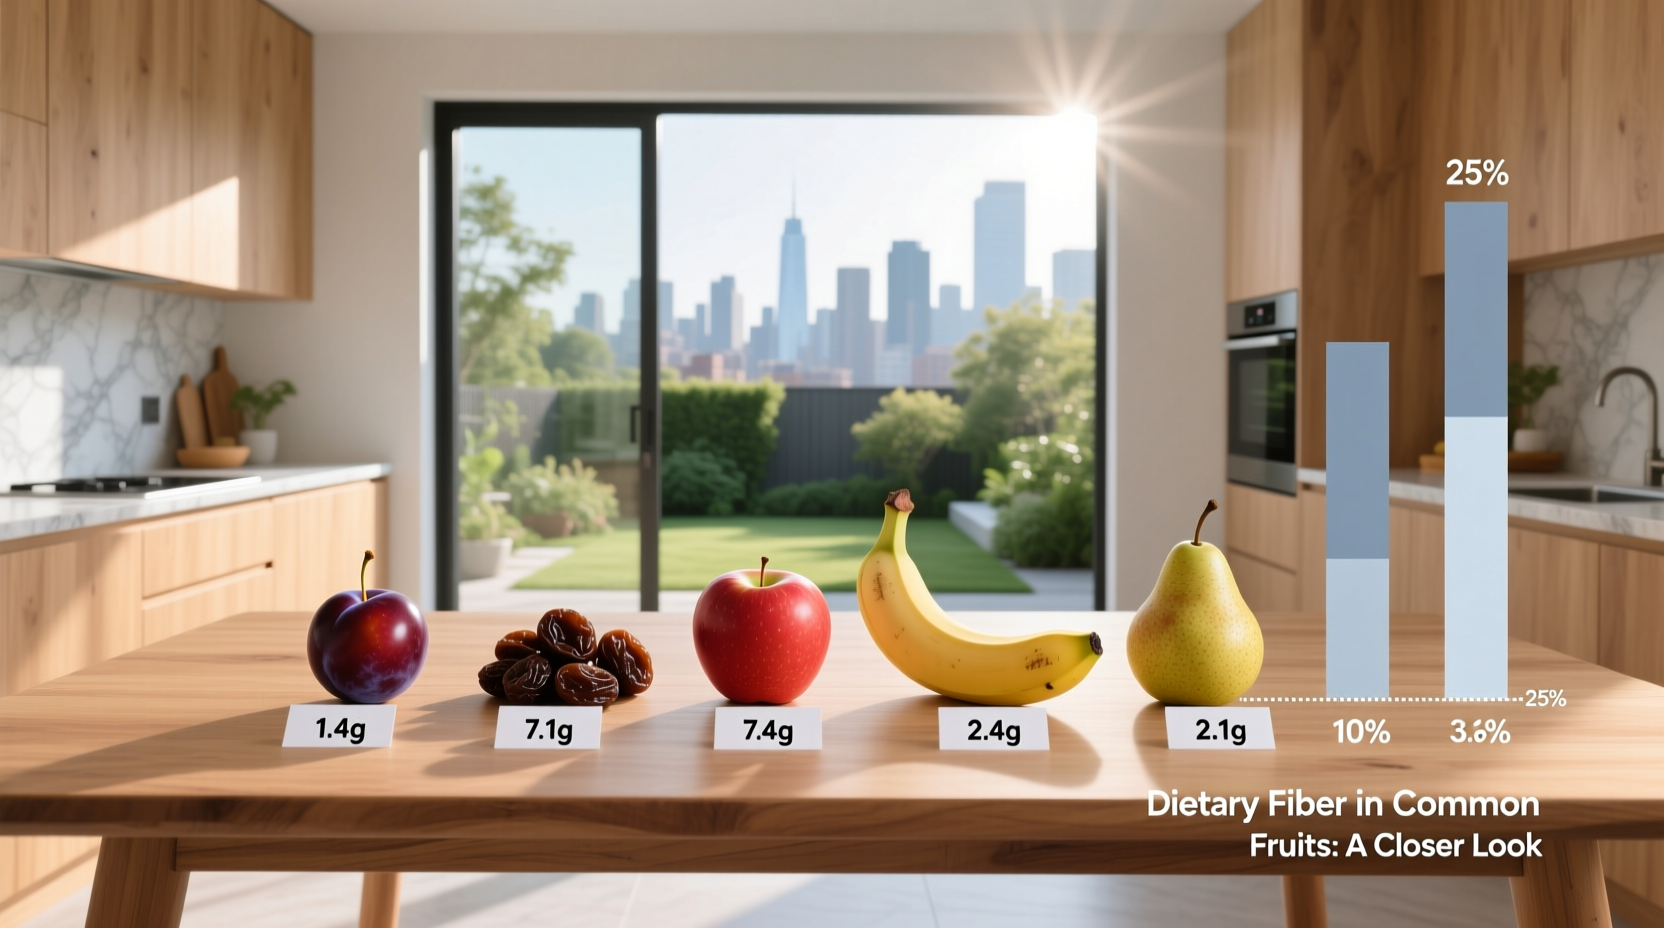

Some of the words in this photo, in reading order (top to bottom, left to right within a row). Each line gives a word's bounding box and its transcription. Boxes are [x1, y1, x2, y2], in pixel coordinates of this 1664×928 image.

[316, 717, 366, 745] 1.4g
[525, 718, 573, 746] 7.1g
[743, 719, 793, 747] 7.4g
[967, 719, 1021, 747] 2.4g
[1195, 718, 1247, 746] 2.1g
